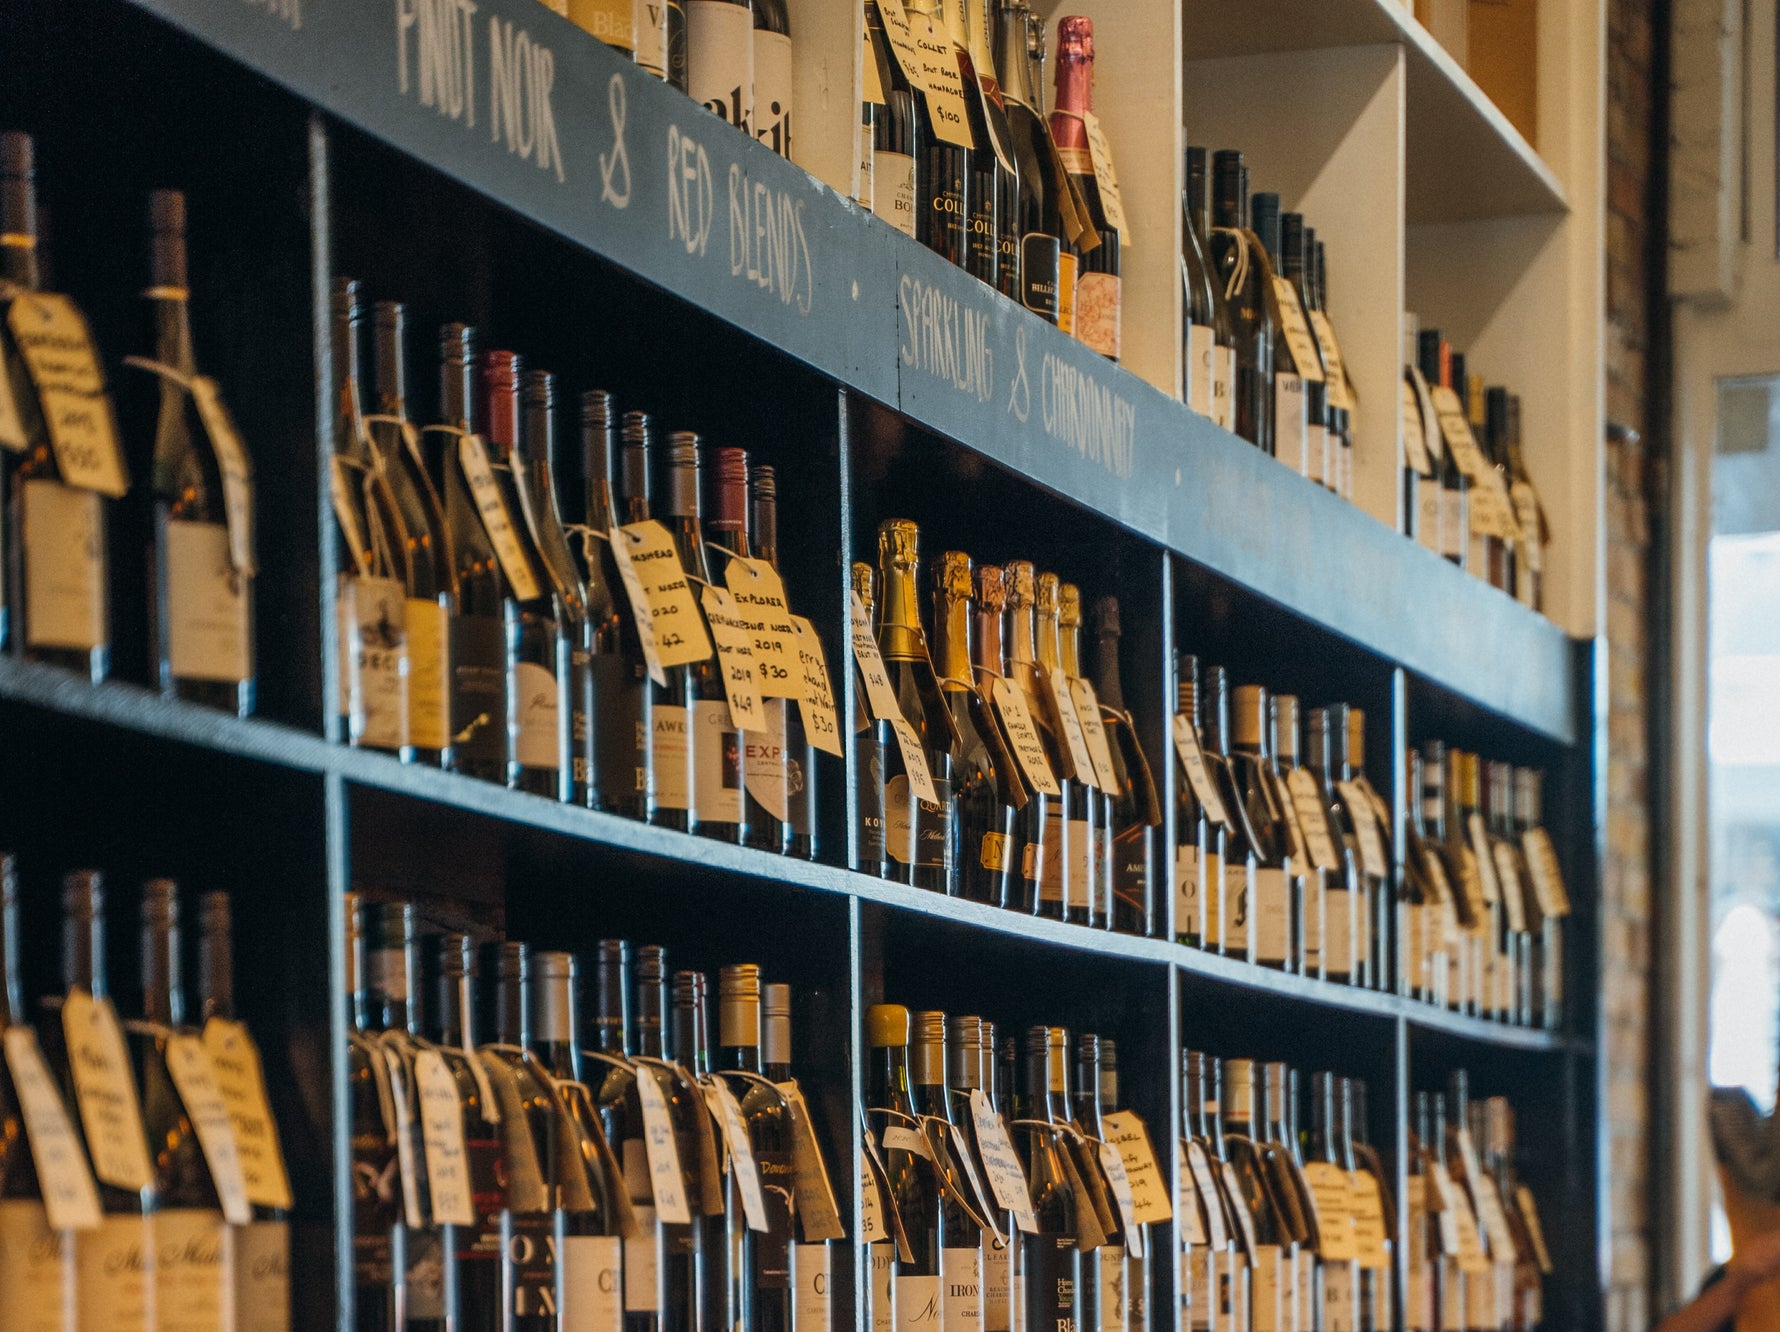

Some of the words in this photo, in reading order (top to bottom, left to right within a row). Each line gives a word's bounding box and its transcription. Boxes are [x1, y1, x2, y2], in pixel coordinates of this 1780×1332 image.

[917, 39, 948, 55] COLLET
[936, 105, 960, 123] $100
[490, 14, 566, 183] NOIR
[599, 71, 632, 209] &
[668, 123, 714, 258] RED
[729, 162, 813, 318] BLENDS
[900, 273, 994, 403] SPARKLING
[1008, 322, 1031, 424] &
[734, 593, 785, 609] EXPLORER
[754, 639, 783, 654] 2019
